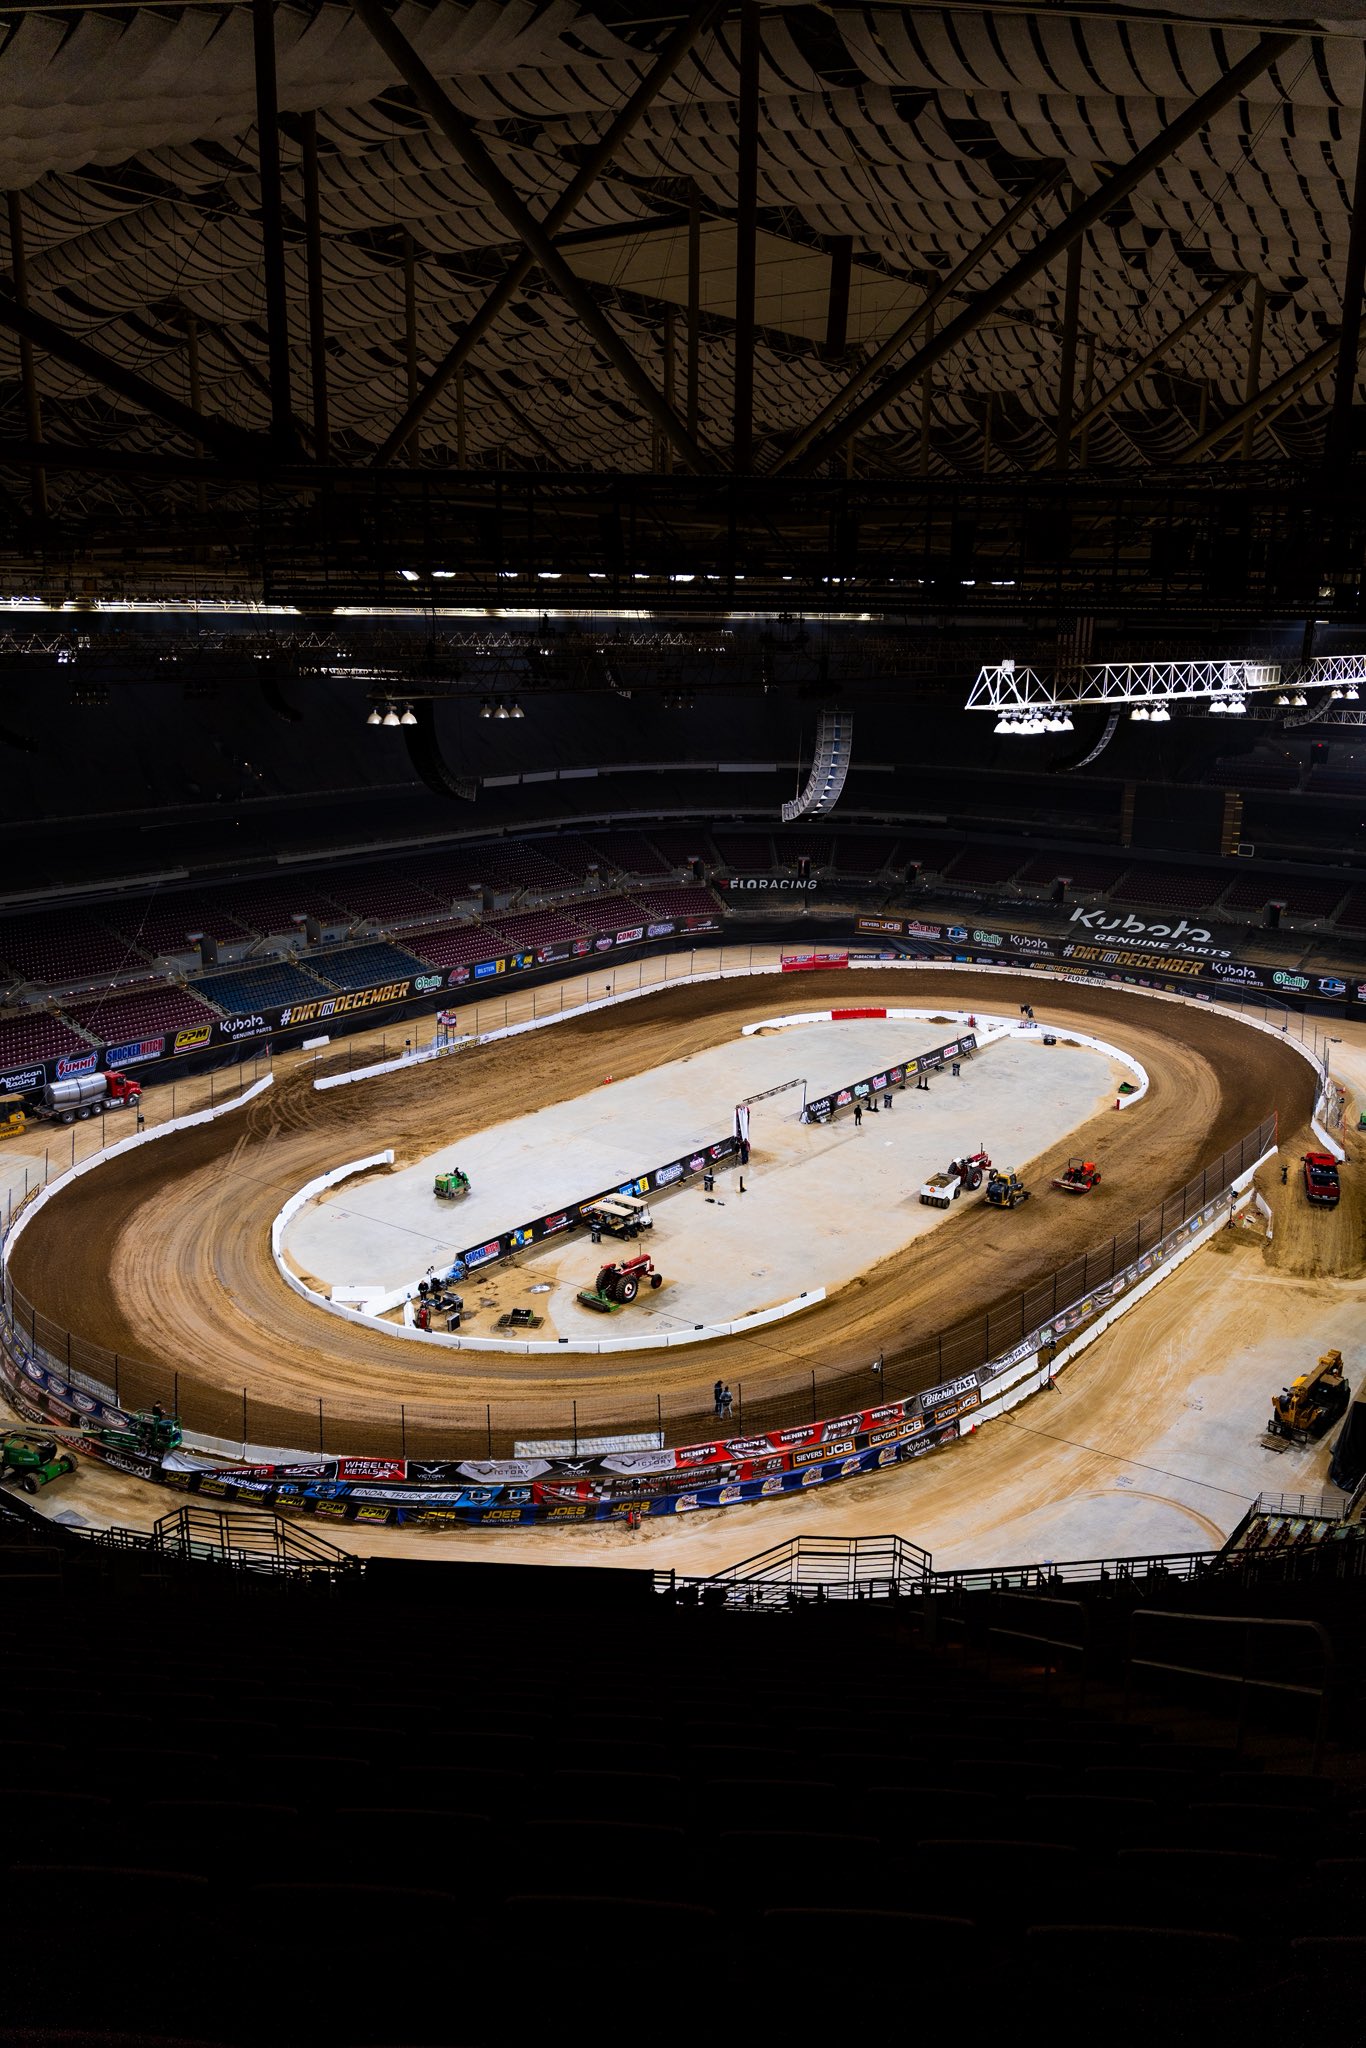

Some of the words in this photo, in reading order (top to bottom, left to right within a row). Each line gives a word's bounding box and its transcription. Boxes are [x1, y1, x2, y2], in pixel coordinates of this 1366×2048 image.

[881, 922, 901, 930] JCB
[1070, 908, 1211, 943] Kubota
[973, 930, 1003, 946] O'Reilly
[1010, 934, 1048, 949] Kubota
[1094, 934, 1171, 949] GENUINE
[1175, 942, 1231, 958] PARTS
[1212, 962, 1256, 979] Kubota
[415, 975, 442, 991] O'Reilly
[1222, 976, 1246, 985] GENUINE
[1247, 979, 1264, 987] PARTS
[1273, 971, 1310, 990] O'Reilly
[220, 1015, 264, 1033] Kubota
[179, 1028, 208, 1043] PPM
[233, 1029, 254, 1040] GENUINE
[256, 1025, 272, 1035] PARTS
[58, 1055, 96, 1078] SUMMIT
[0, 1070, 42, 1084] American
[6, 1077, 37, 1089] Racing
[955, 1377, 976, 1392] FAST
[959, 1394, 978, 1411] JCB
[871, 1430, 897, 1443] SIEVERS
[899, 1419, 923, 1435] JCB
[796, 1450, 823, 1463] SIEVERS
[826, 1441, 853, 1456] JCB
[344, 1468, 379, 1476] METALS
[345, 1461, 399, 1470] WHEELER
[354, 1488, 387, 1498] TINDAL
[390, 1491, 424, 1500] TRUCK
[360, 1507, 386, 1517] PPM
[483, 1509, 521, 1519] JOES
[547, 1506, 586, 1516] JOES
